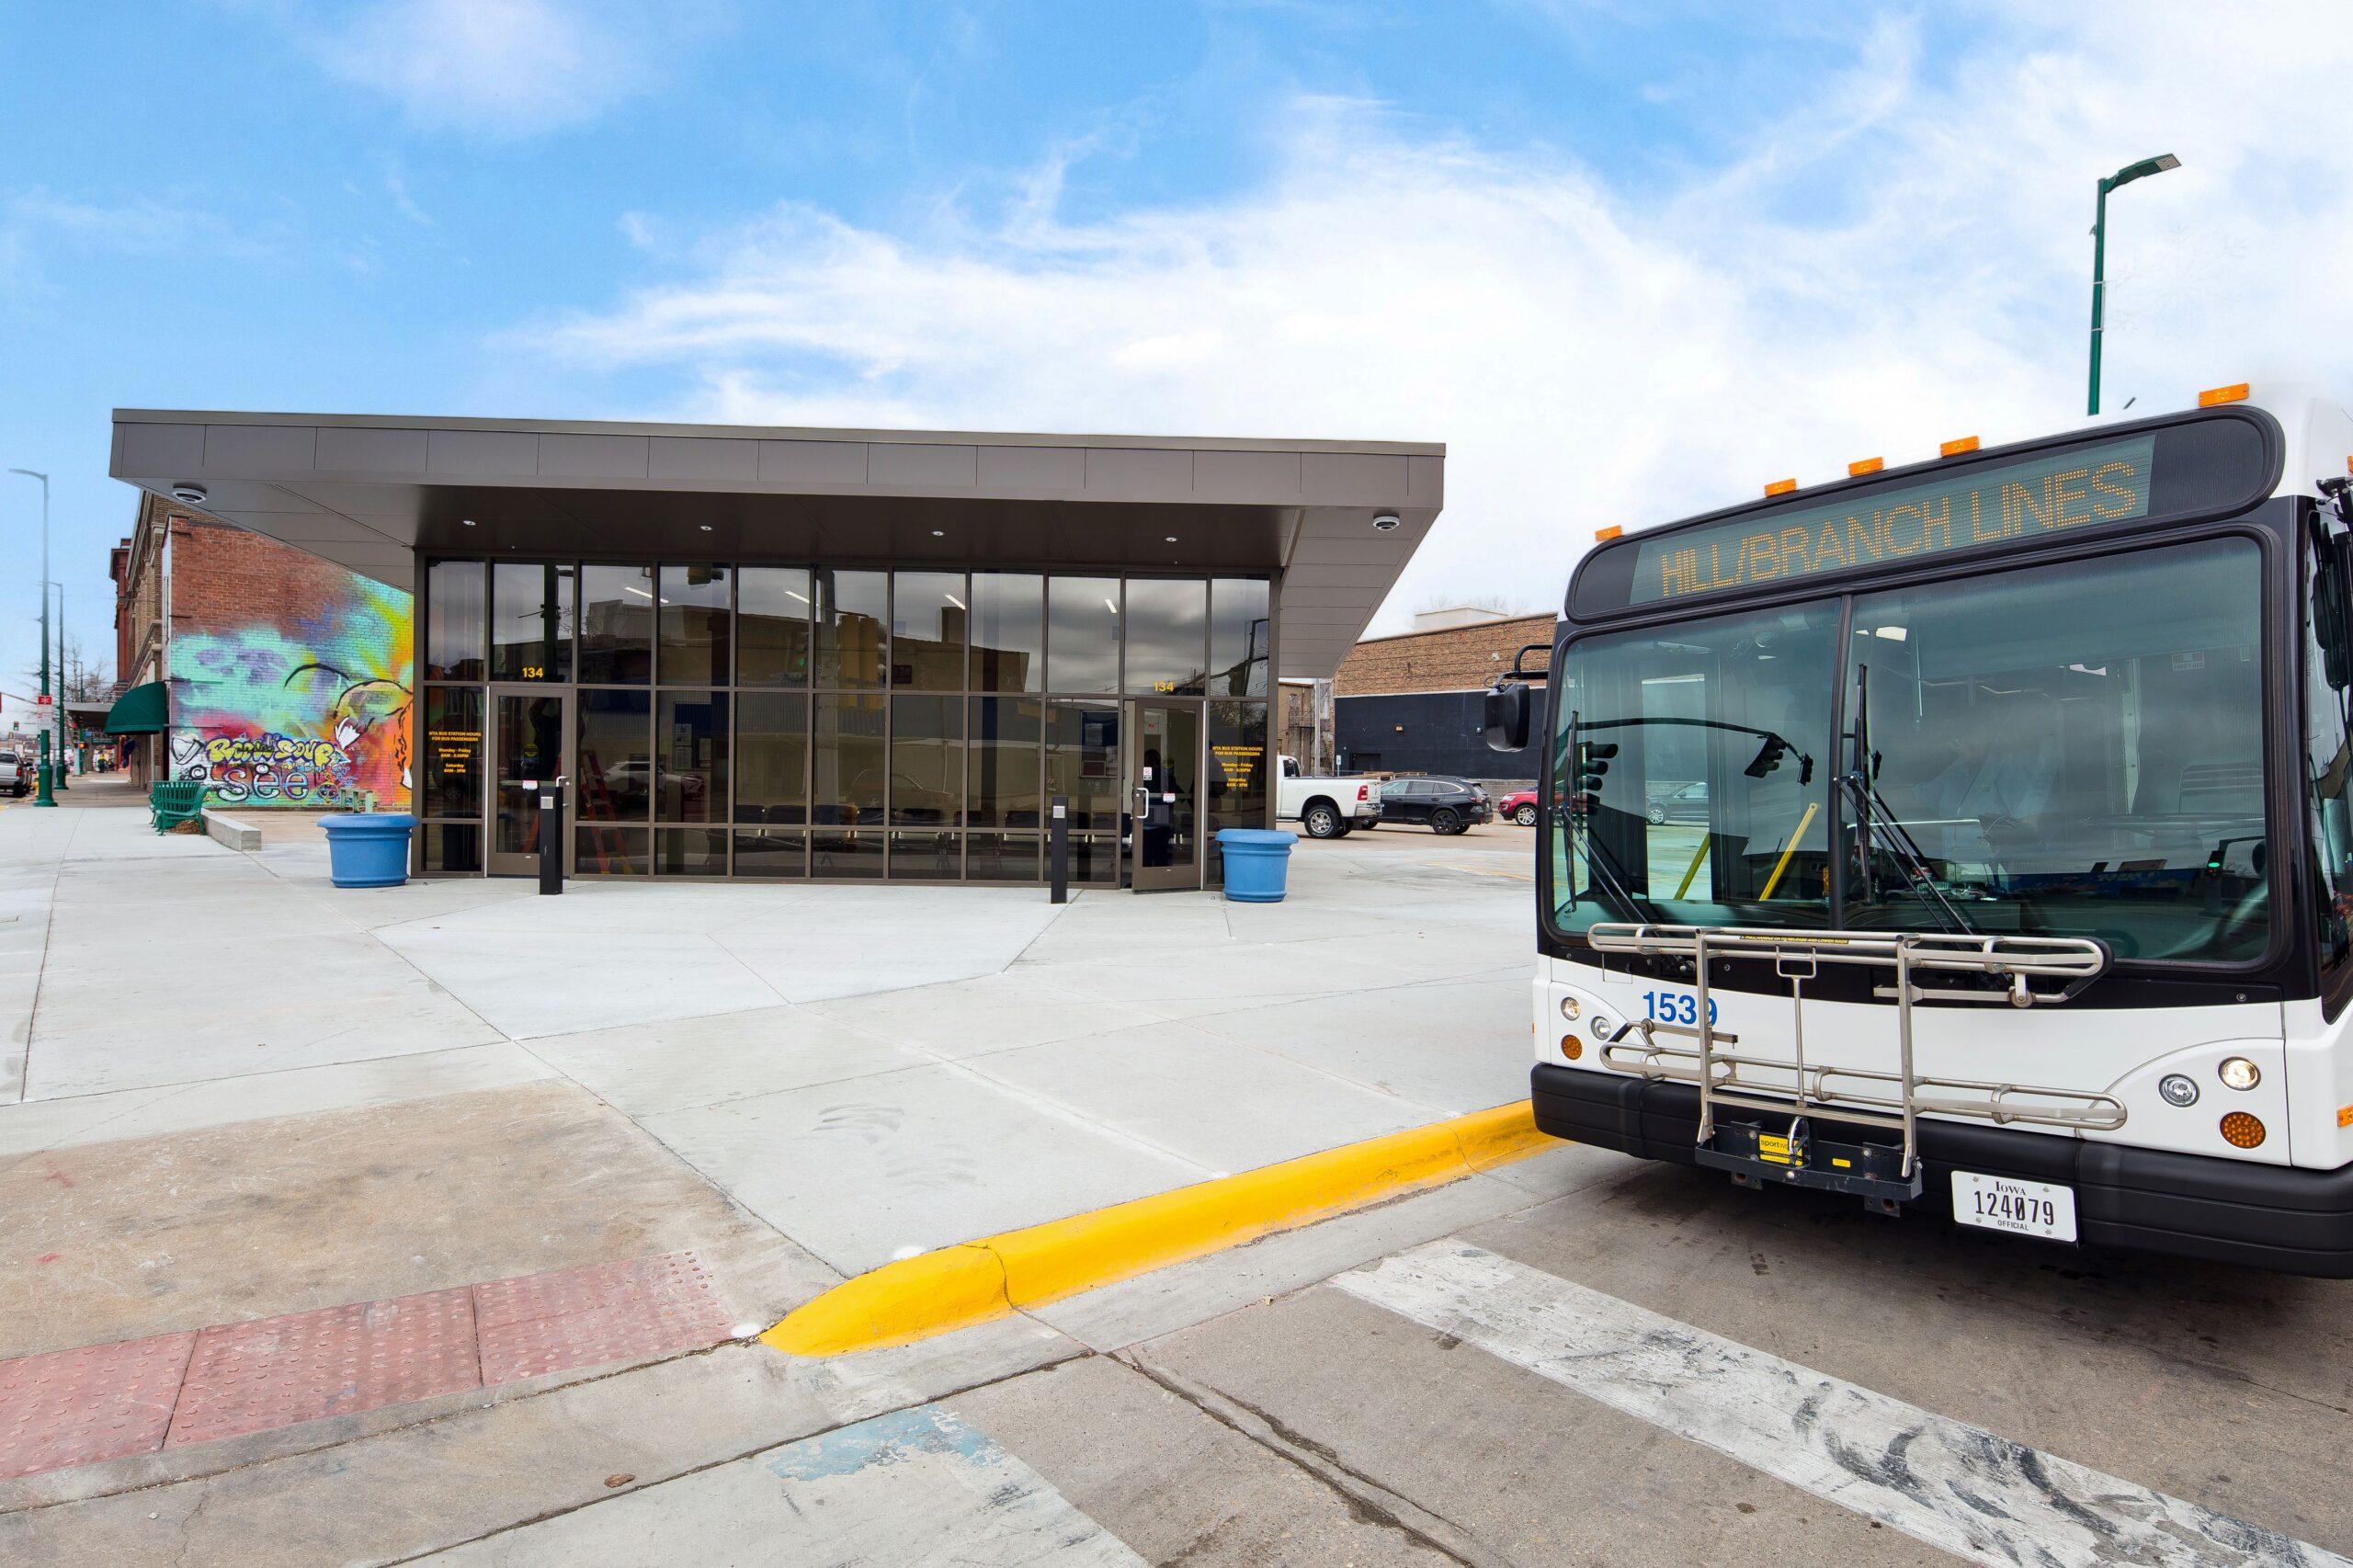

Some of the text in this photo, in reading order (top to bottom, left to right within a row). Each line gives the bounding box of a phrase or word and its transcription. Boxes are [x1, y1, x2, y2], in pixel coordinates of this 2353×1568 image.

[1660, 461, 2137, 597] HILL/BRANCH LINES
[522, 666, 544, 678] 134
[1154, 681, 1175, 692] 134
[1974, 1190, 2055, 1226] 124079
[1997, 1219, 2029, 1232] OFFICIAL
